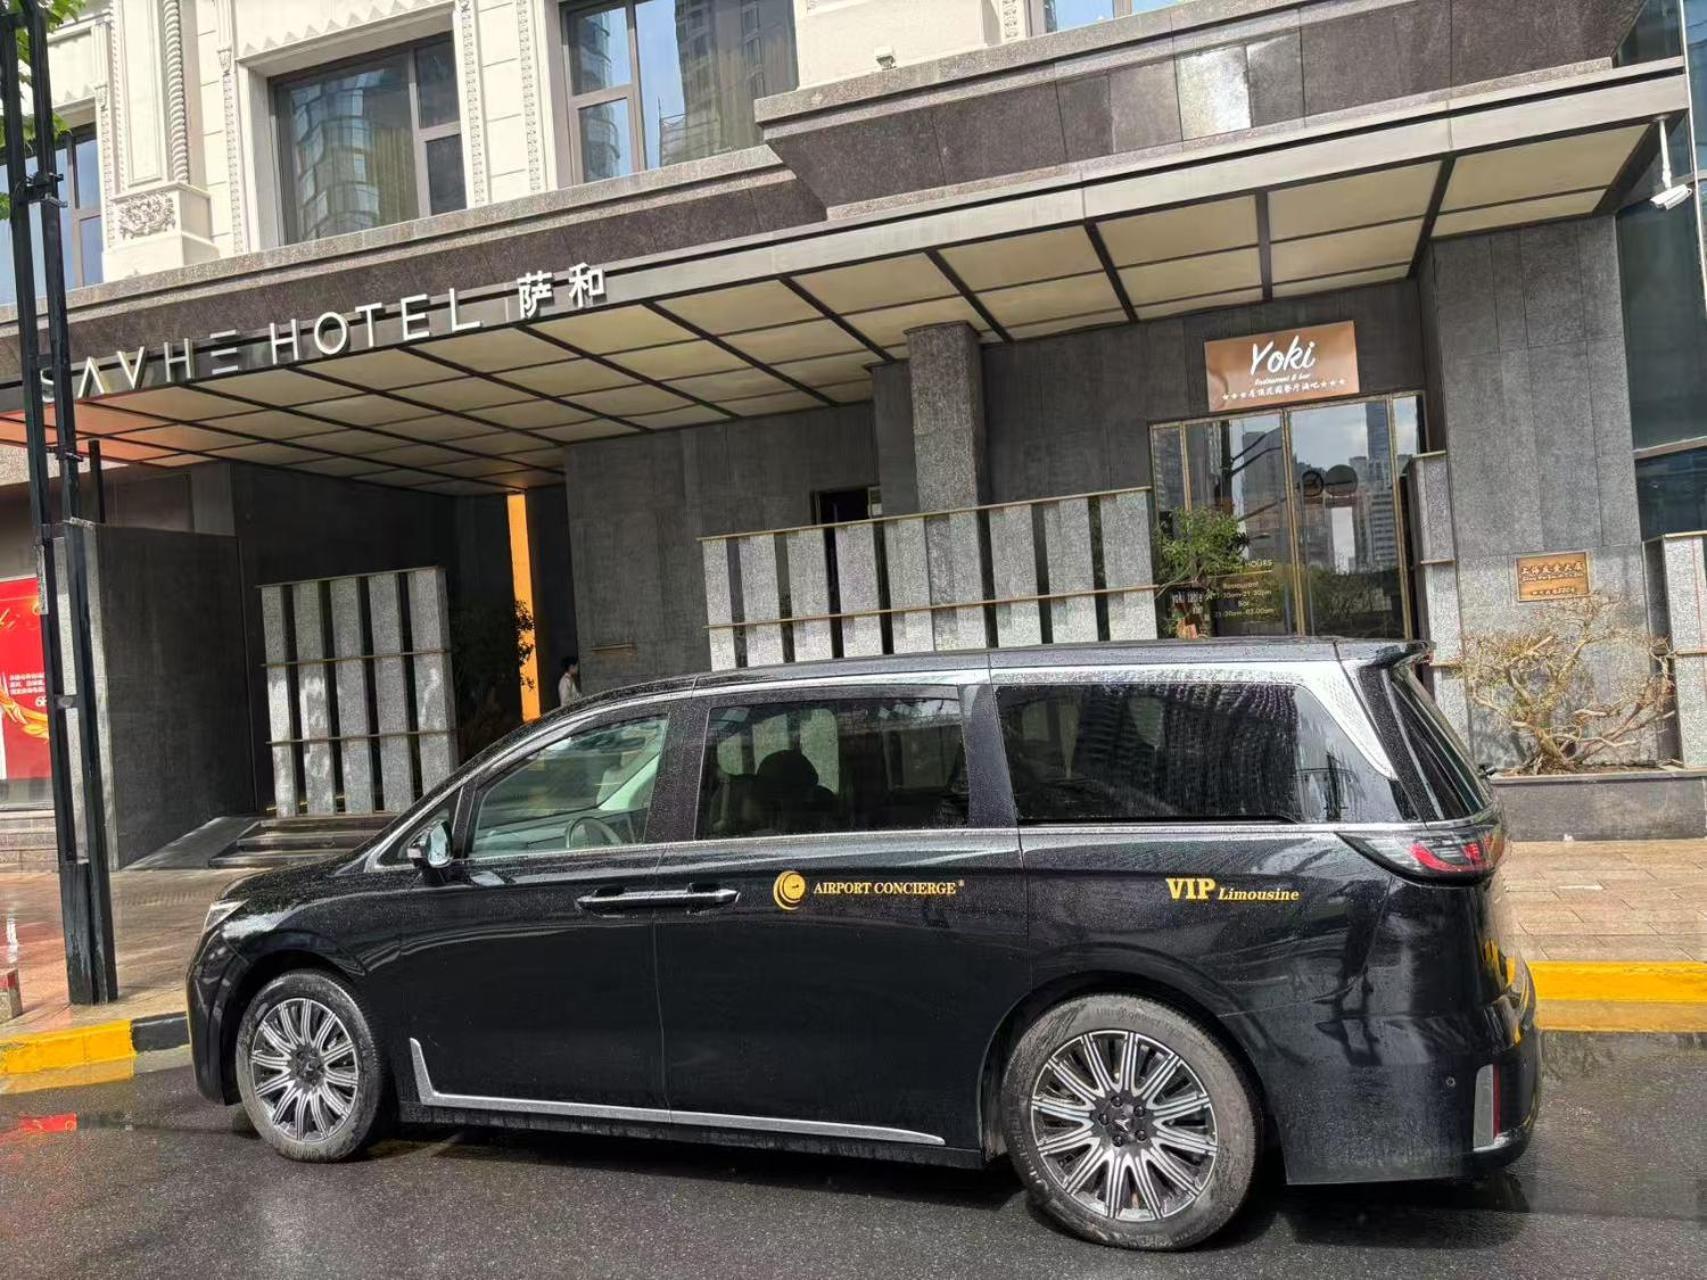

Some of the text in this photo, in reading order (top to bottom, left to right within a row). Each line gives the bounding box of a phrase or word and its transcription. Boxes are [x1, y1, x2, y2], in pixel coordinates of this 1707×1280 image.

[269, 287, 482, 365] HOTEL
[516, 262, 605, 319] 萨和
[1249, 335, 1316, 375] Yoki
[813, 882, 872, 895] AIRPORT
[1165, 878, 1300, 901] VIP Limousine
